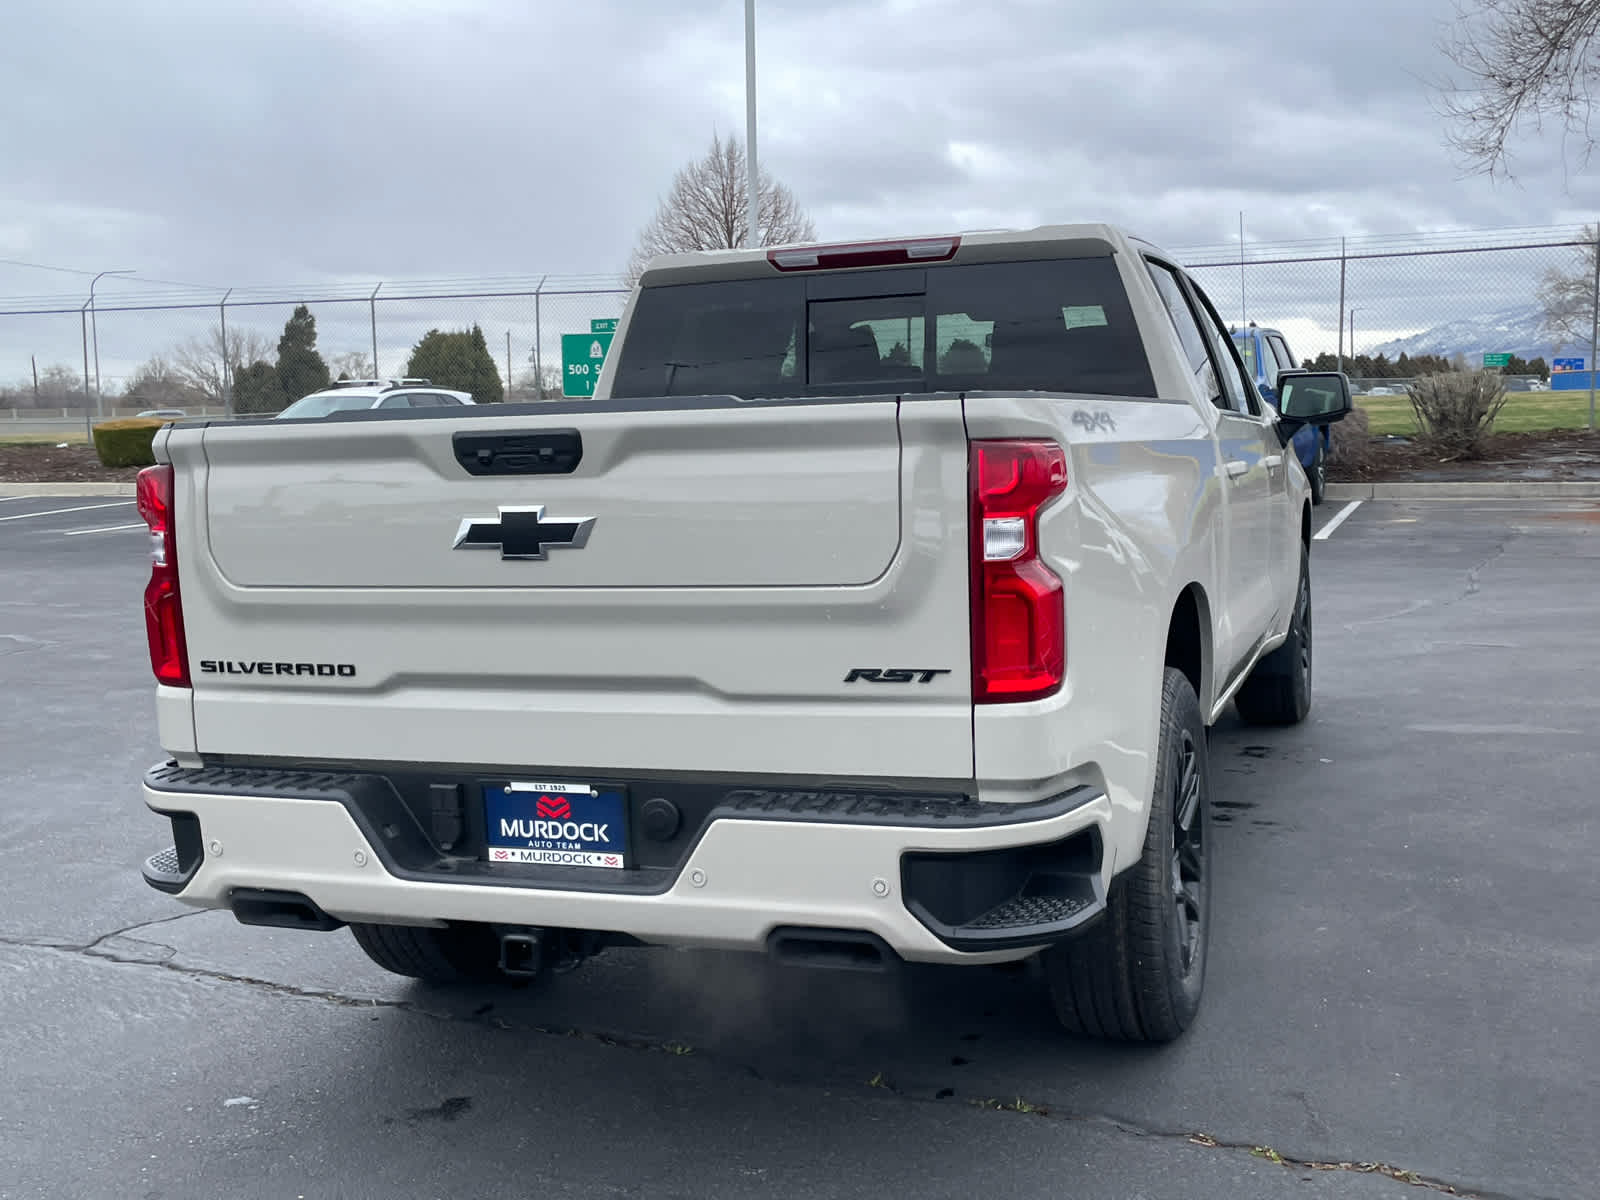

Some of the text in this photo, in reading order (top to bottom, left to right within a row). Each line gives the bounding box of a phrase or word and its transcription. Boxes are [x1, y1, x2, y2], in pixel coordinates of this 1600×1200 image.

[568, 364, 589, 375] 500
[200, 660, 356, 677] SILVERADO
[843, 668, 952, 683] RST
[500, 818, 609, 842] MURDOCK
[528, 840, 581, 849] AUTO TEAM
[520, 851, 592, 864] MURDOCK
